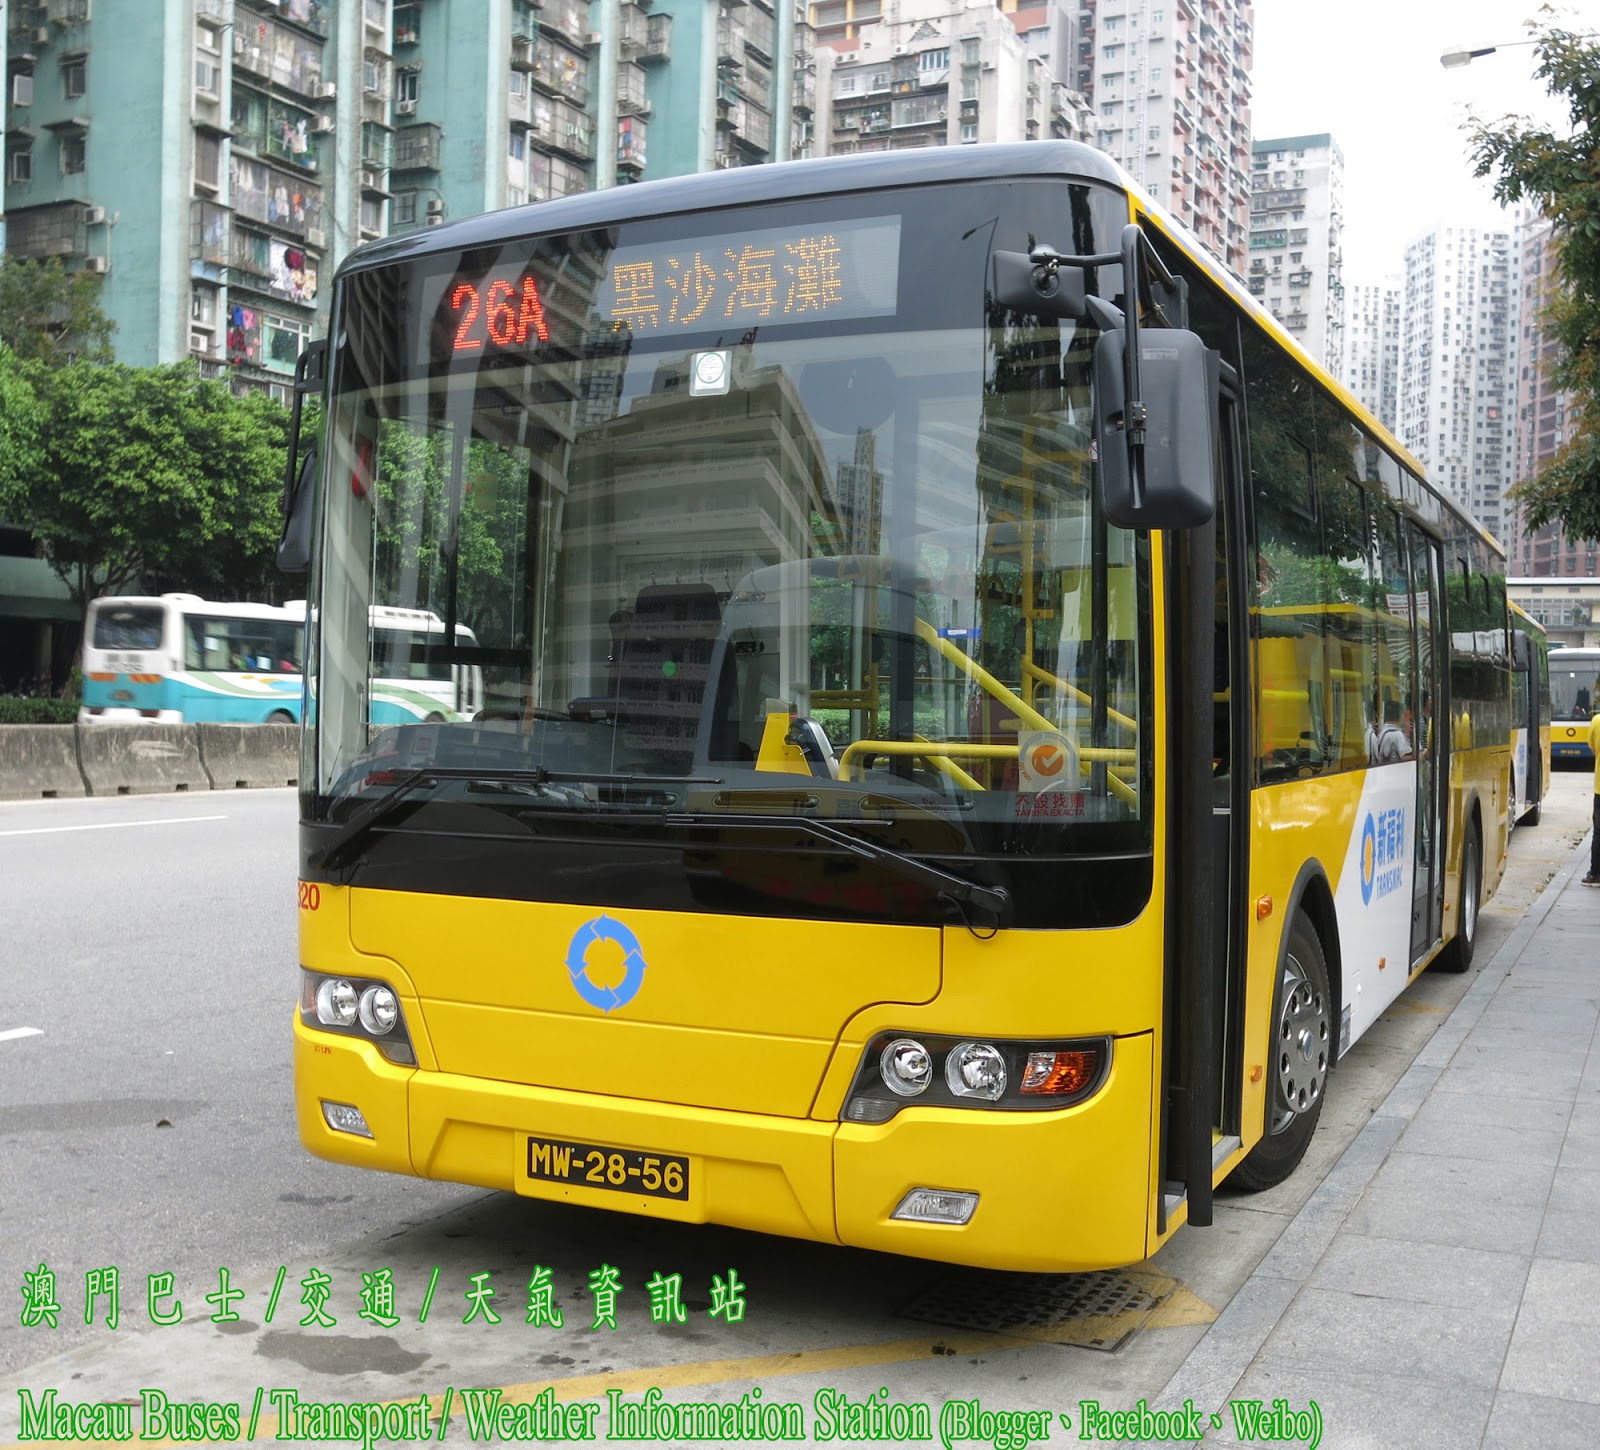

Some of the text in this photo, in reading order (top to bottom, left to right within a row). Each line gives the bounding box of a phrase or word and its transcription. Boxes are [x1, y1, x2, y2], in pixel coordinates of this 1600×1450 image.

[452, 276, 548, 350] 26A
[610, 234, 842, 332] 黑沙海灘
[1015, 809, 1085, 817] TARIFA EXACTA
[531, 1142, 684, 1194] MW-28-56
